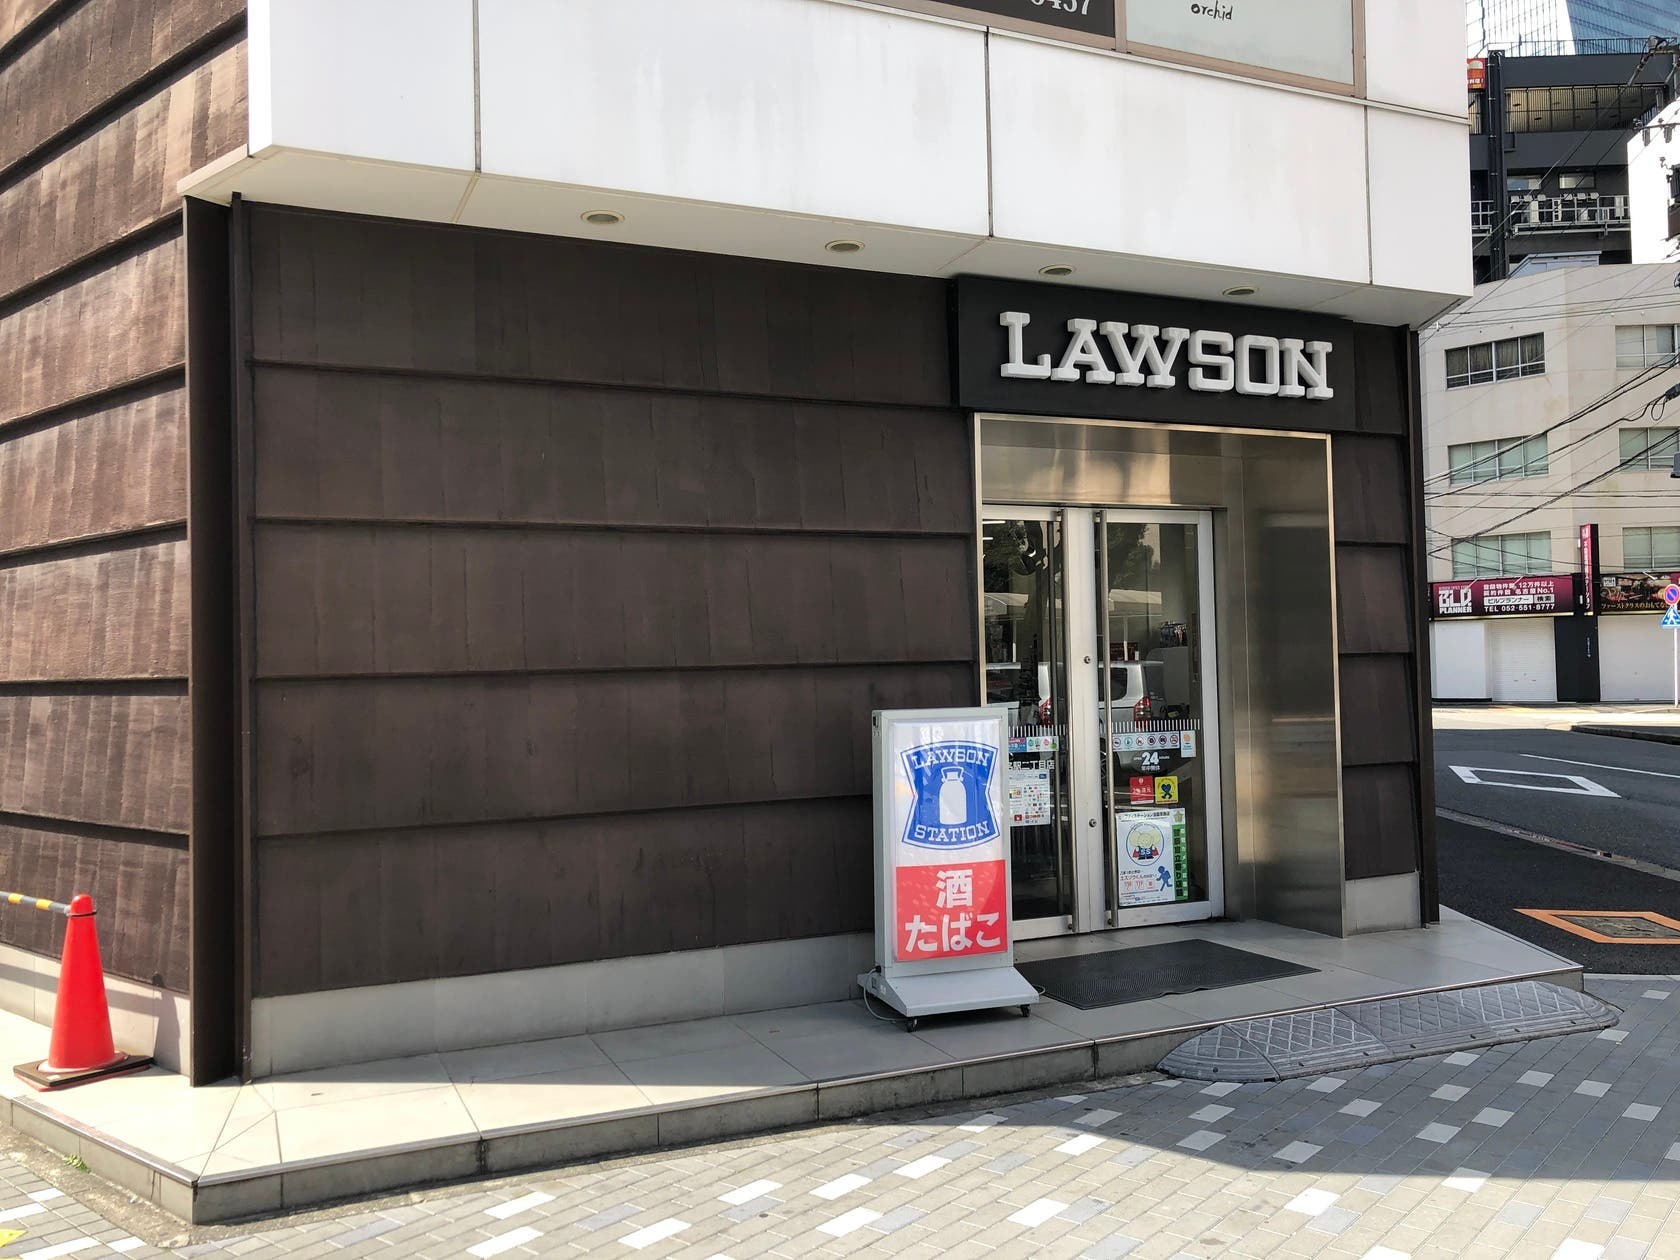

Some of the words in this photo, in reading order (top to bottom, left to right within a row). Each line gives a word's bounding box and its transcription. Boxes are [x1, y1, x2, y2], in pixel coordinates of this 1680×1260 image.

[1191, 0, 1233, 20] orchid
[1000, 311, 1334, 400] LAWSON
[1440, 606, 1472, 614] PLANNER
[911, 748, 989, 769] LAWSON
[1142, 752, 1159, 765] 24
[914, 821, 990, 842] STATION
[936, 869, 973, 908] 酒
[905, 912, 1000, 952] たばこ
